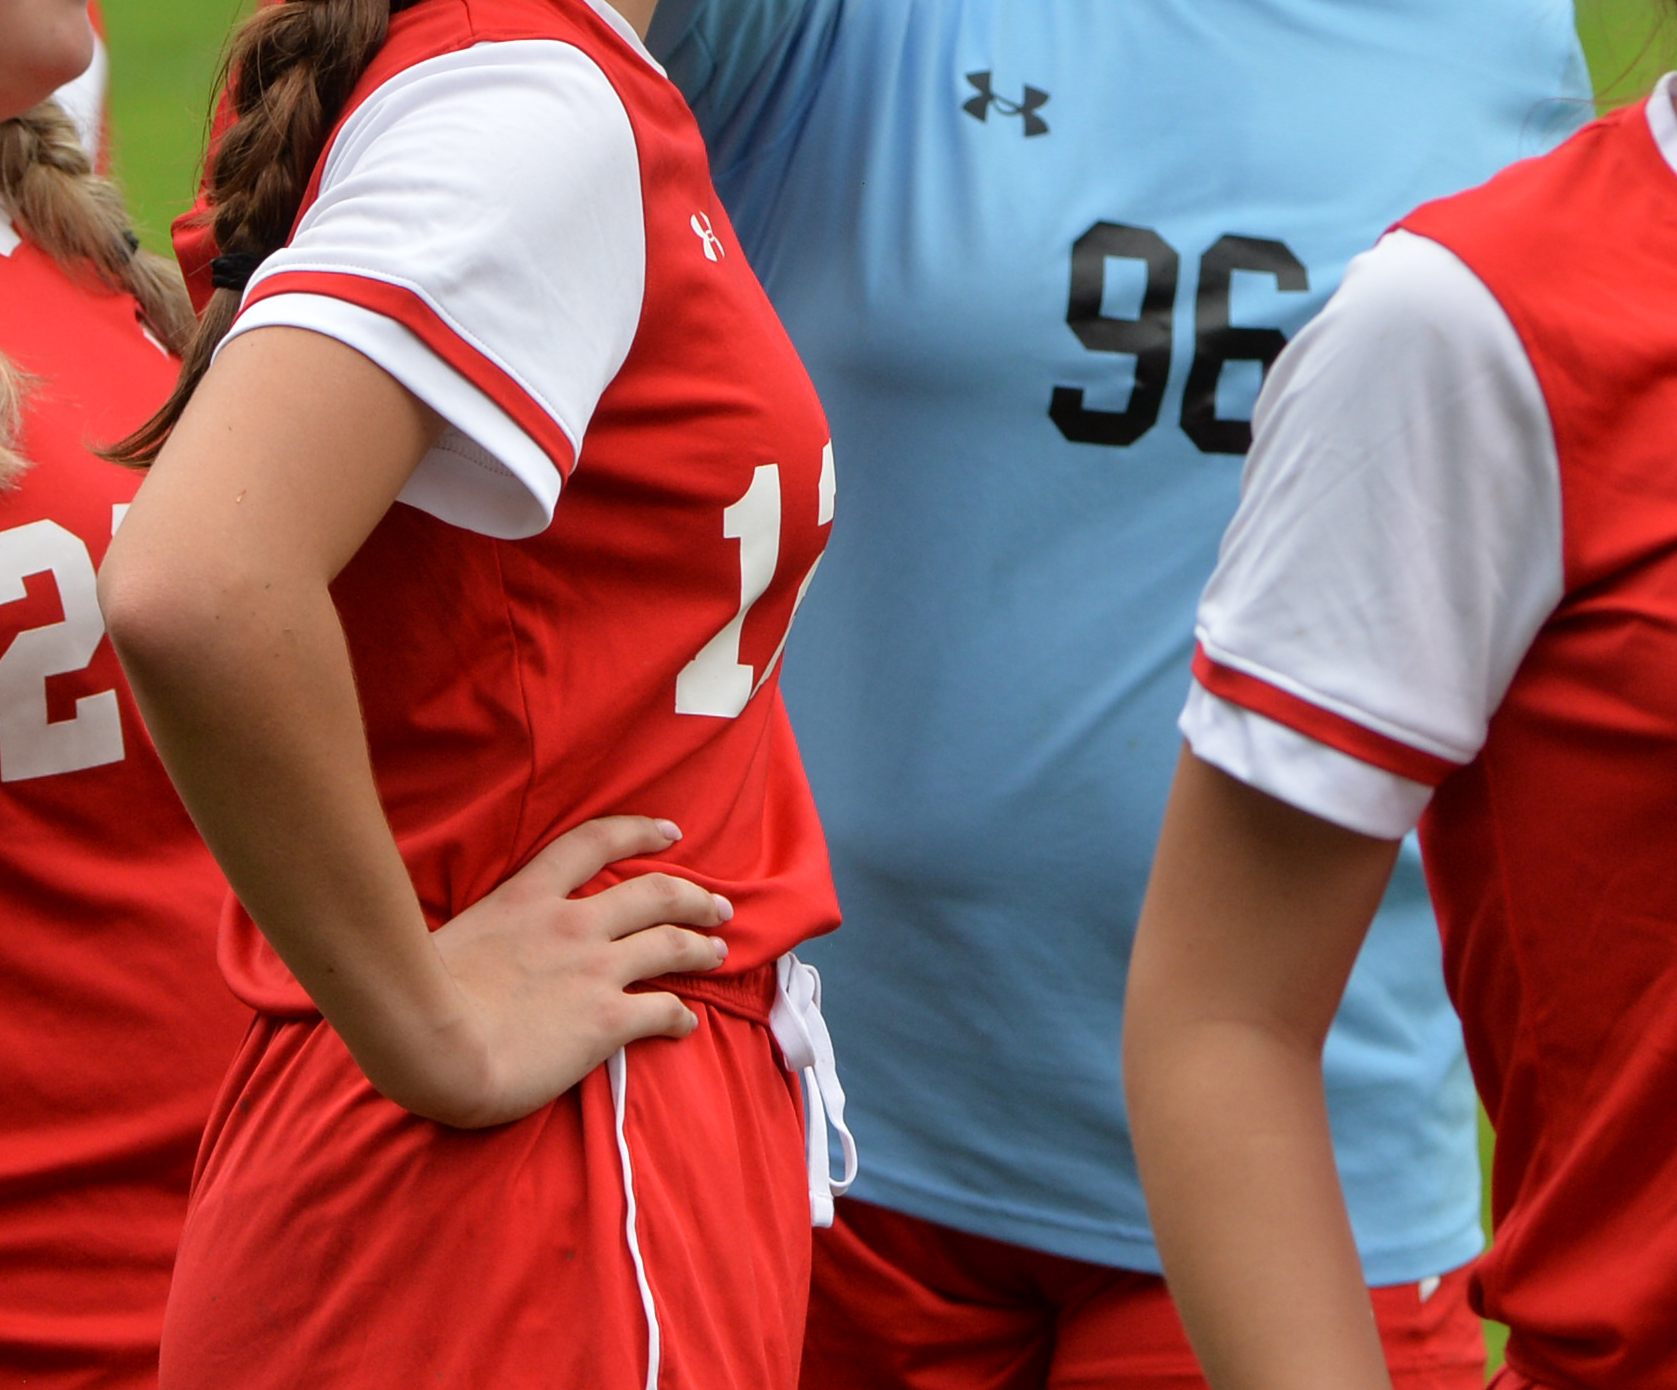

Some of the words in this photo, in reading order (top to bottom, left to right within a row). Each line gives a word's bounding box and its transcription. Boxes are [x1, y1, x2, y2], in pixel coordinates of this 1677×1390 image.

[1048, 221, 1310, 455] 96
[0, 503, 131, 783] 2
[674, 438, 837, 719] 1
